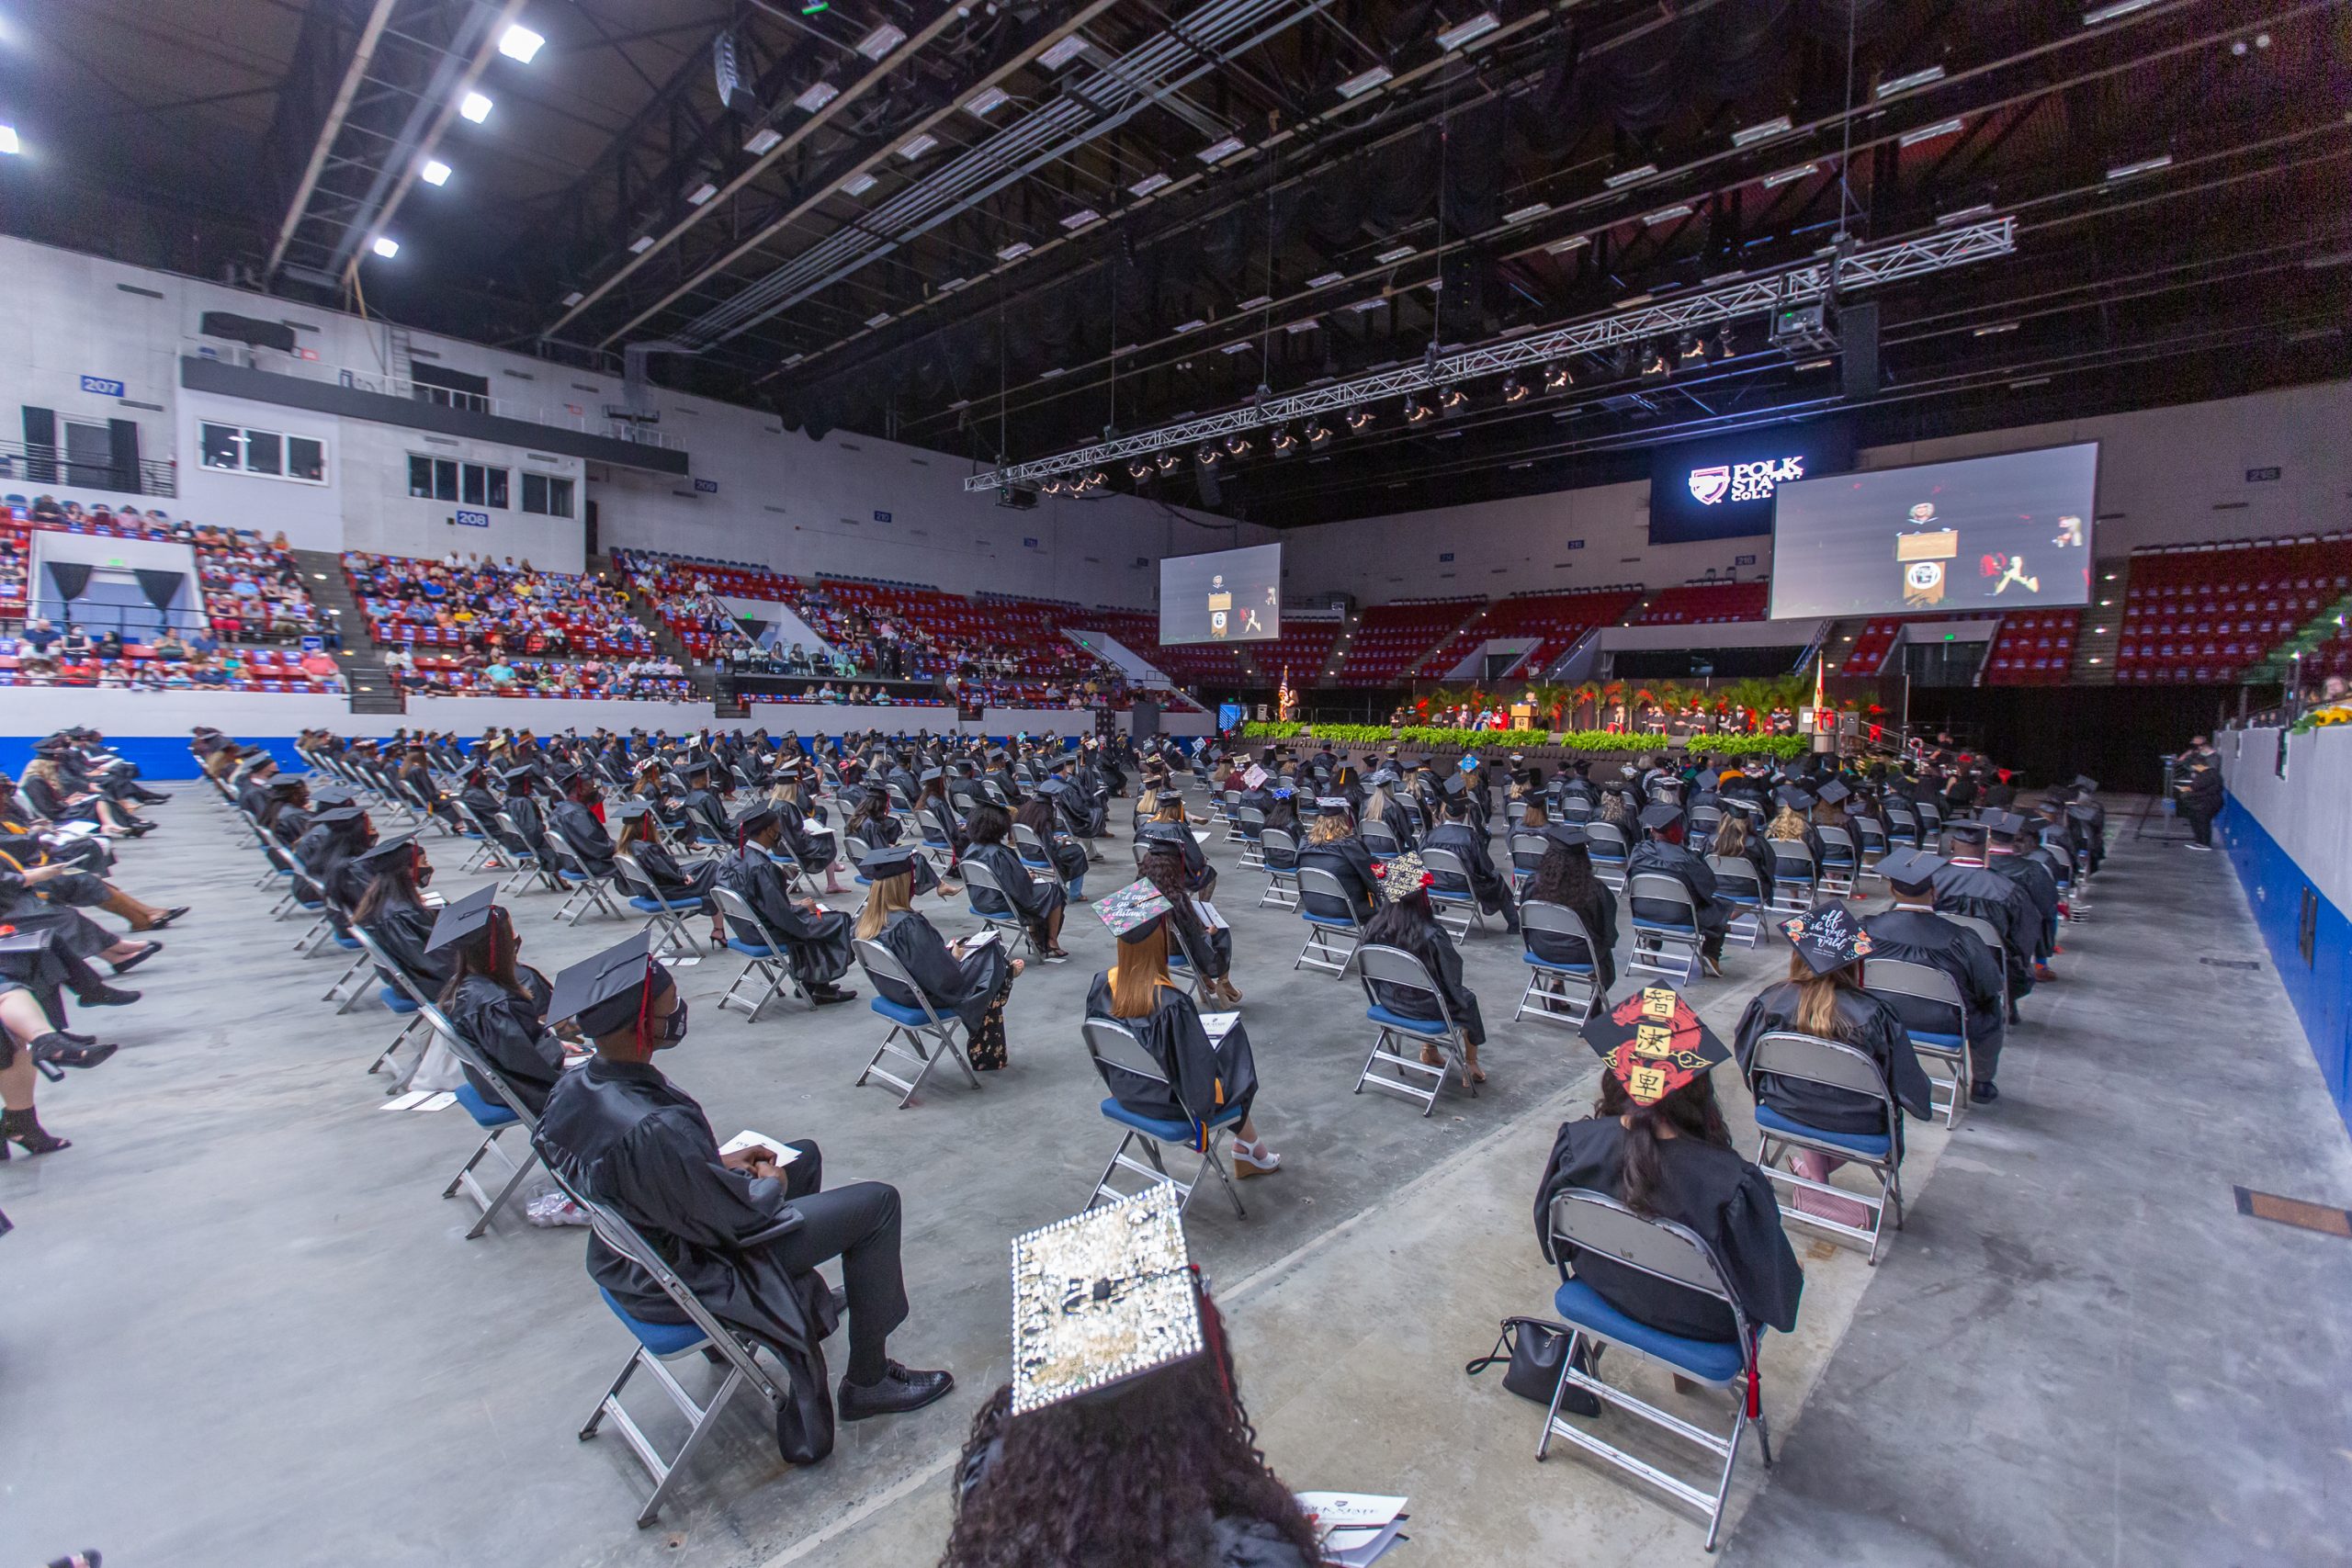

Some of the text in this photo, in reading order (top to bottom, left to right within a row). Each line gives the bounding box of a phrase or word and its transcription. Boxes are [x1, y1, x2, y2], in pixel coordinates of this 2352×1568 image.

[84, 378, 119, 394] 207
[1733, 456, 1804, 479] POLK
[695, 479, 716, 491] 209
[1731, 489, 1772, 502] COLL
[459, 513, 486, 525] 208
[1385, 887, 1407, 897] TODO
[1110, 901, 1129, 911] go
[1821, 909, 1844, 930] off
[1809, 921, 1825, 931] she
[1825, 928, 1847, 938] went
[1817, 936, 1848, 951] world
[1643, 989, 1675, 1014] 智
